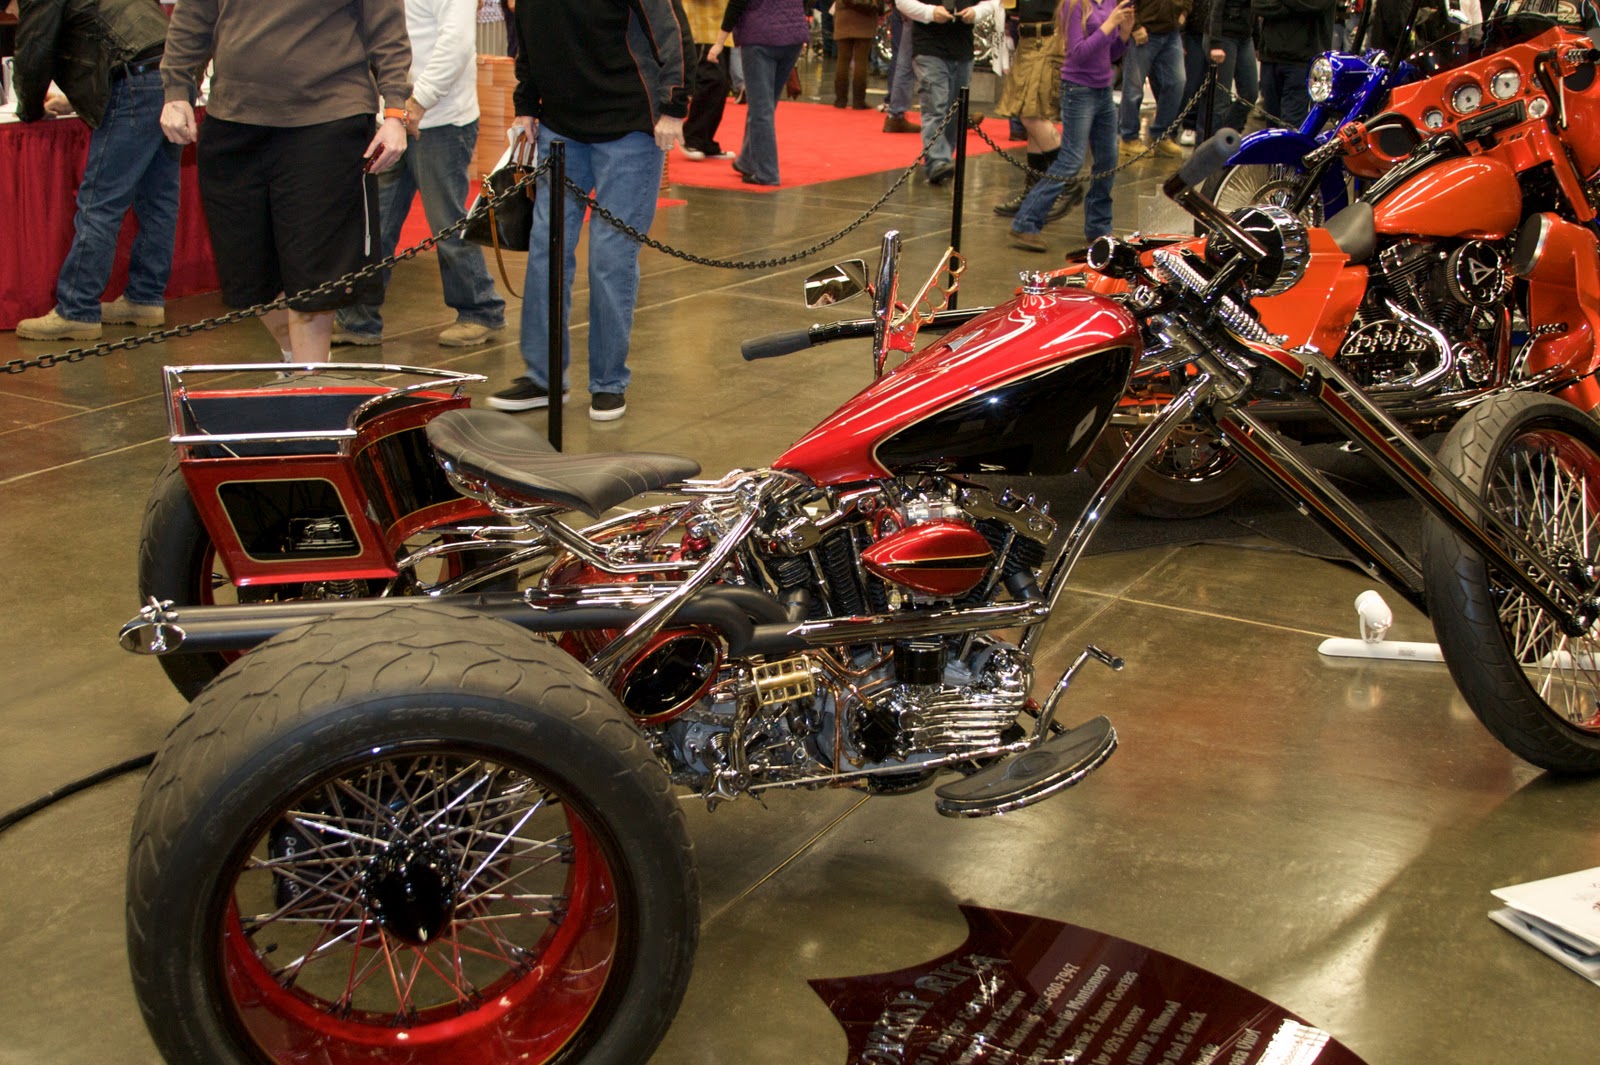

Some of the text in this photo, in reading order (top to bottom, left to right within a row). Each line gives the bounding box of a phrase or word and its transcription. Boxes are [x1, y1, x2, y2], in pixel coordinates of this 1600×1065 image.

[1065, 963, 1111, 1010] Montgomery
[862, 990, 935, 1065] OVELY
[1112, 1005, 1145, 1036] Forever
